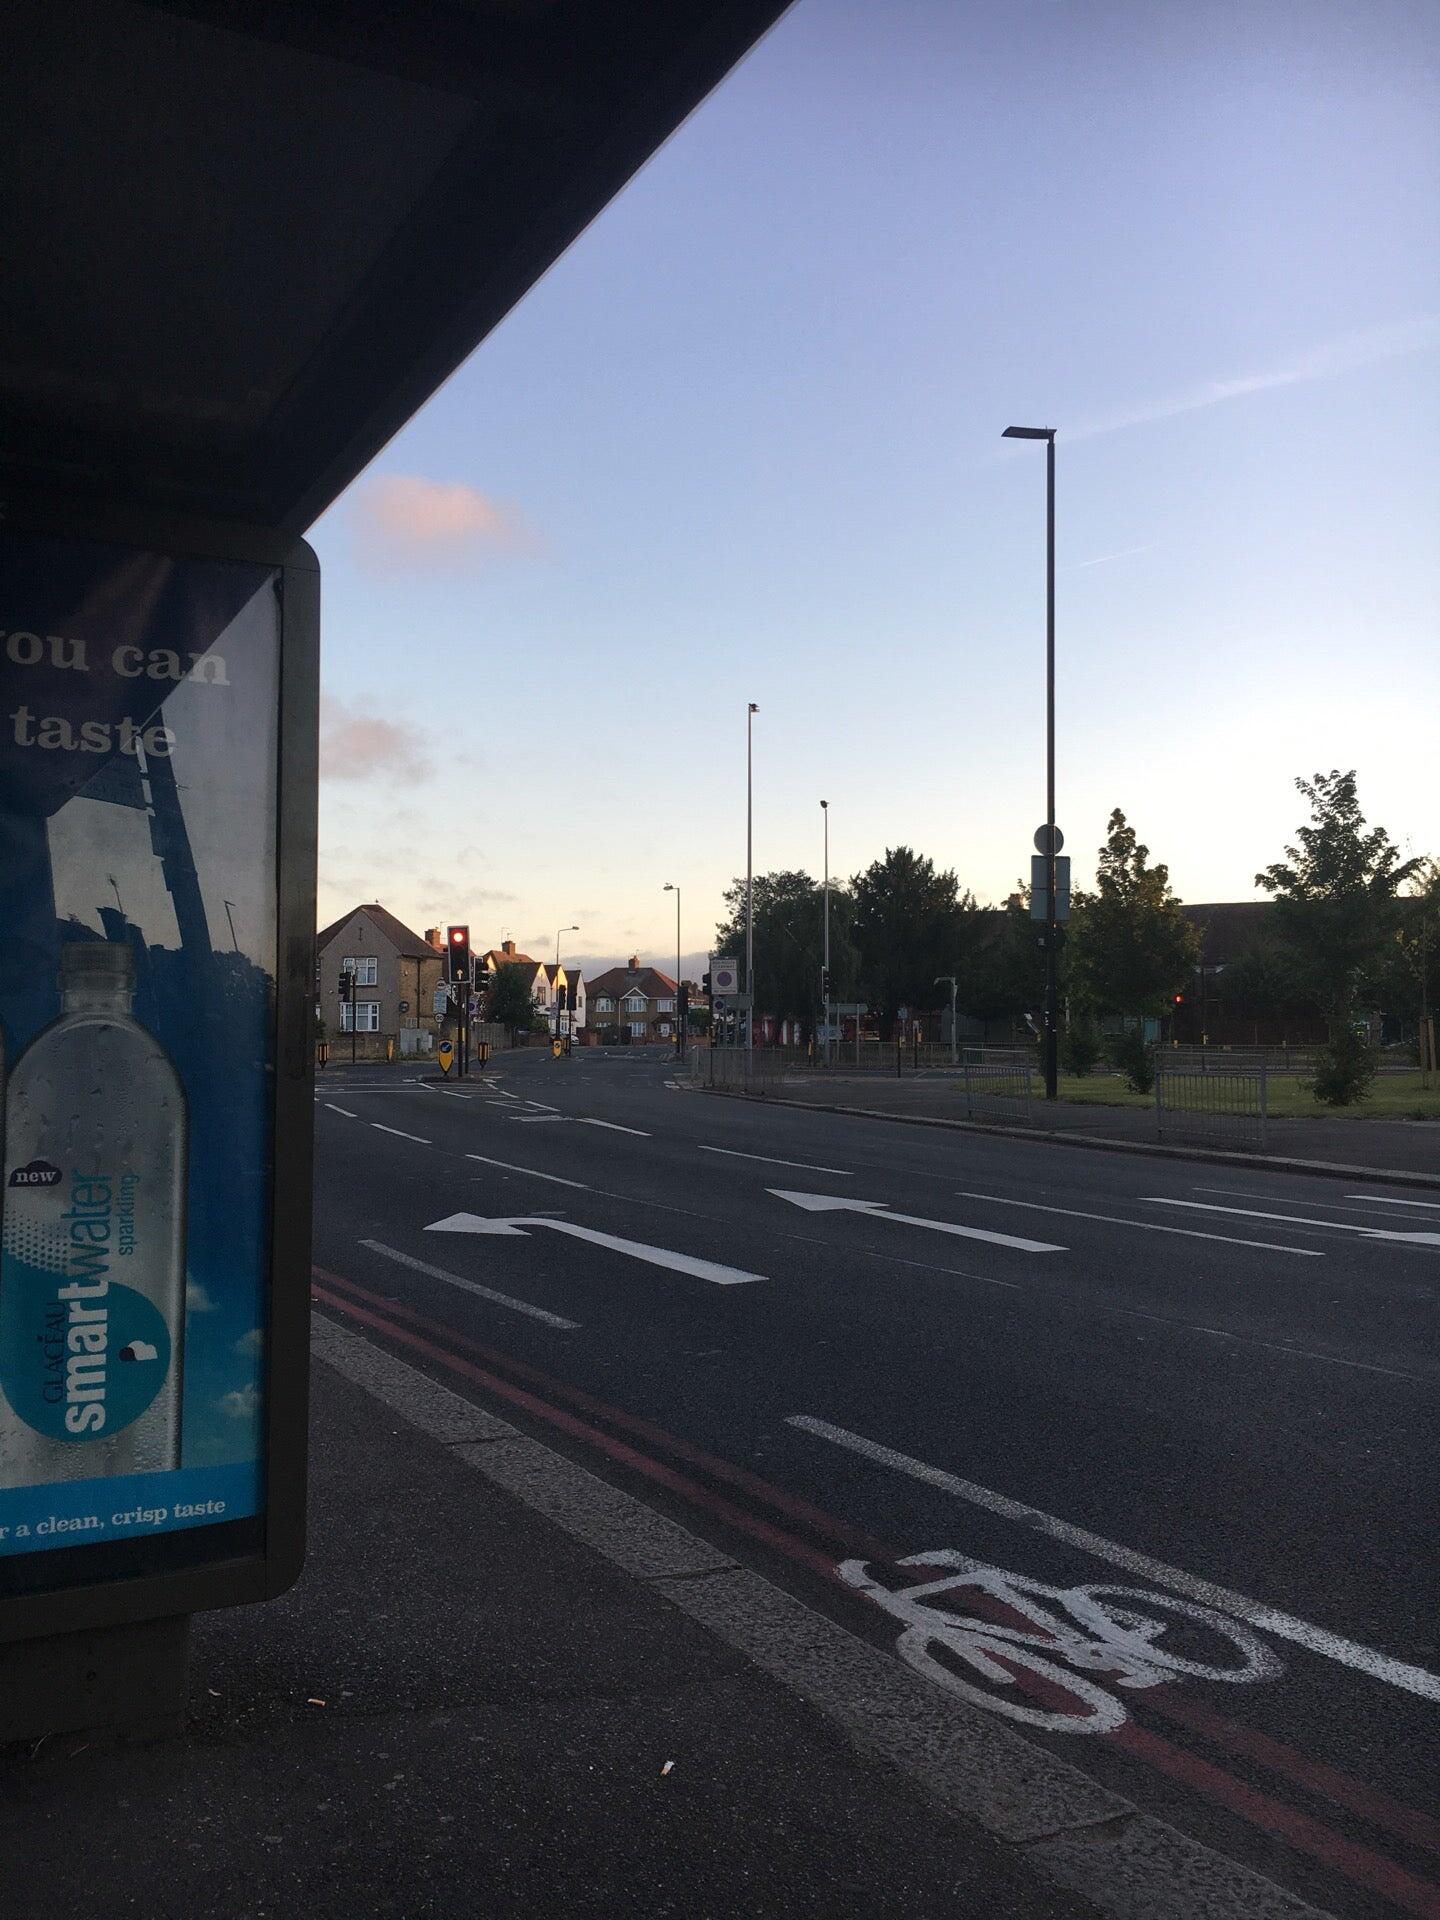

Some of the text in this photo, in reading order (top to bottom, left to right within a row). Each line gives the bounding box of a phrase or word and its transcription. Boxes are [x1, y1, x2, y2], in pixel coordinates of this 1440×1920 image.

[0, 630, 230, 686] ou can
[9, 705, 177, 758] taste
[15, 1169, 57, 1183] new
[118, 1173, 140, 1256] sparkling
[15, 1524, 31, 1538] a
[36, 1516, 105, 1535] clean,
[111, 1505, 168, 1526] crisp
[173, 1499, 226, 1518] taste
